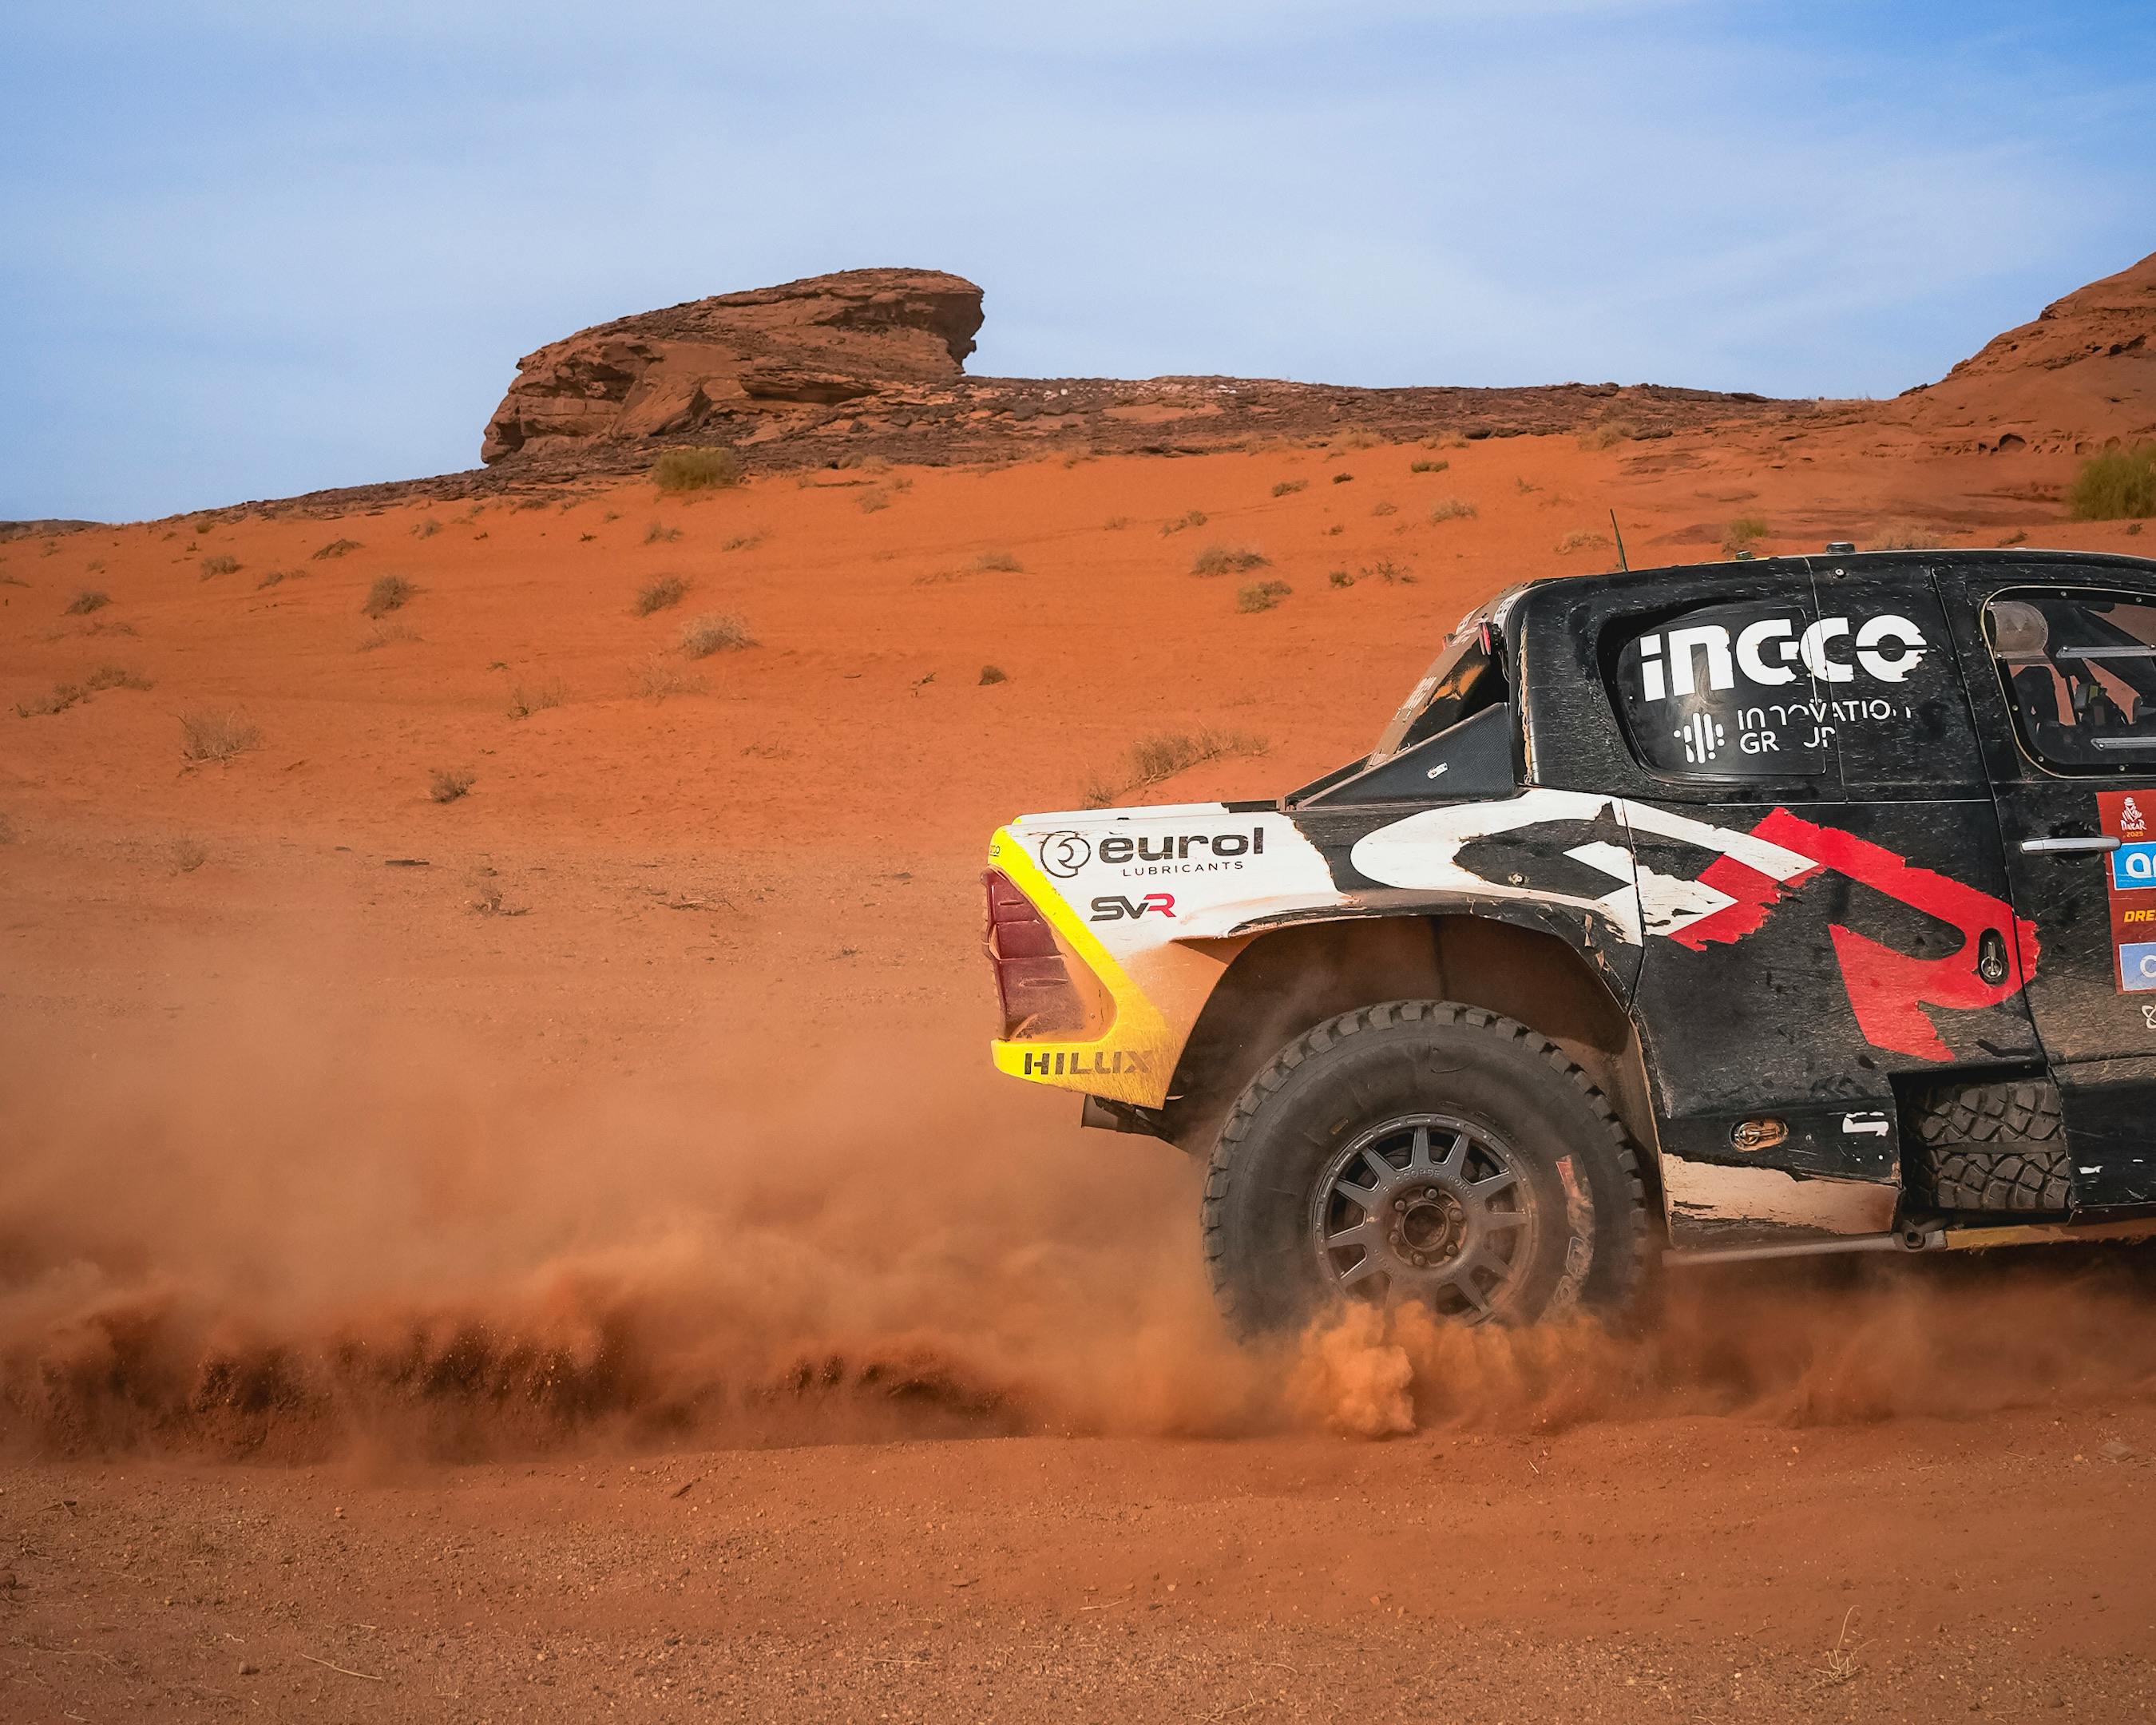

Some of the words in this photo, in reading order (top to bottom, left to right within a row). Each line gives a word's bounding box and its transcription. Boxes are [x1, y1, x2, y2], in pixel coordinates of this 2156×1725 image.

[1099, 827, 1264, 864] eurol
[1123, 861, 1244, 877] LUBRICANTS
[1089, 893, 1177, 922] SVR
[1024, 1050, 1152, 1075] HILUX
